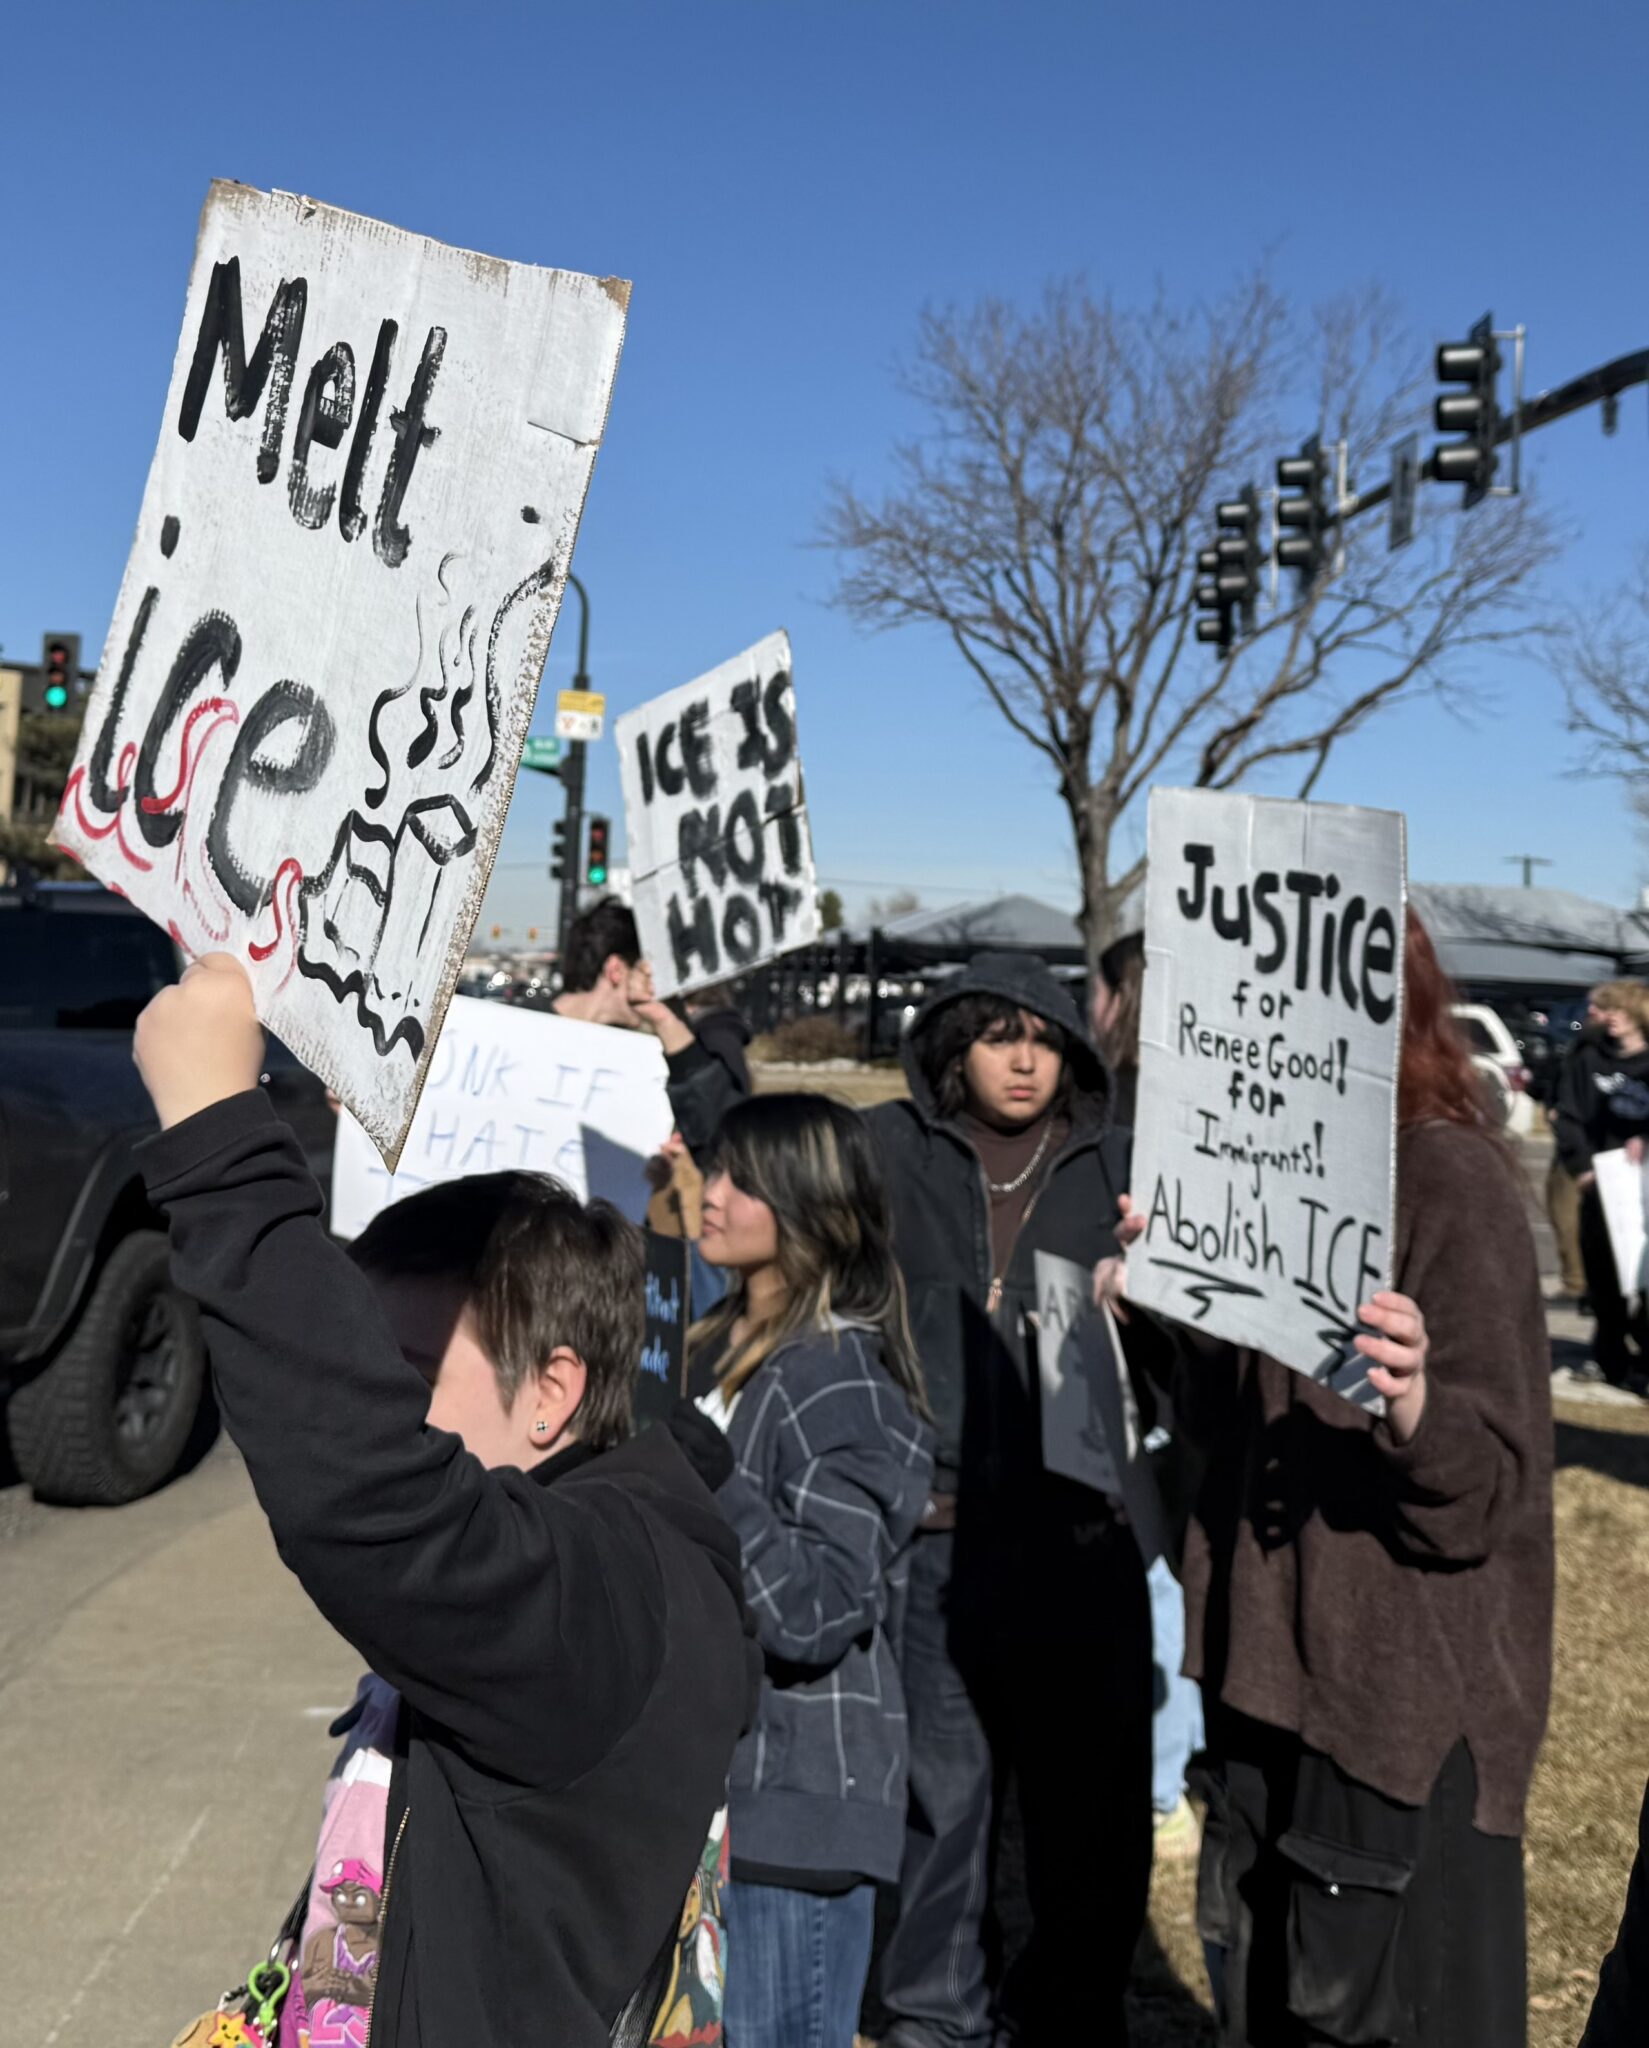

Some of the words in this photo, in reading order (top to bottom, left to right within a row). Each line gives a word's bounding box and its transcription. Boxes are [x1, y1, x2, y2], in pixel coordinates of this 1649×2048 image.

[178, 256, 447, 568] Melt
[636, 697, 718, 807] ICE
[730, 669, 794, 780] IS
[678, 782, 801, 900] NOT
[667, 881, 803, 984] HOT
[1232, 980, 1293, 1029] for
[535, 1062, 622, 1113] IF
[1228, 1072, 1286, 1118] for
[1146, 1173, 1285, 1278] Abolish
